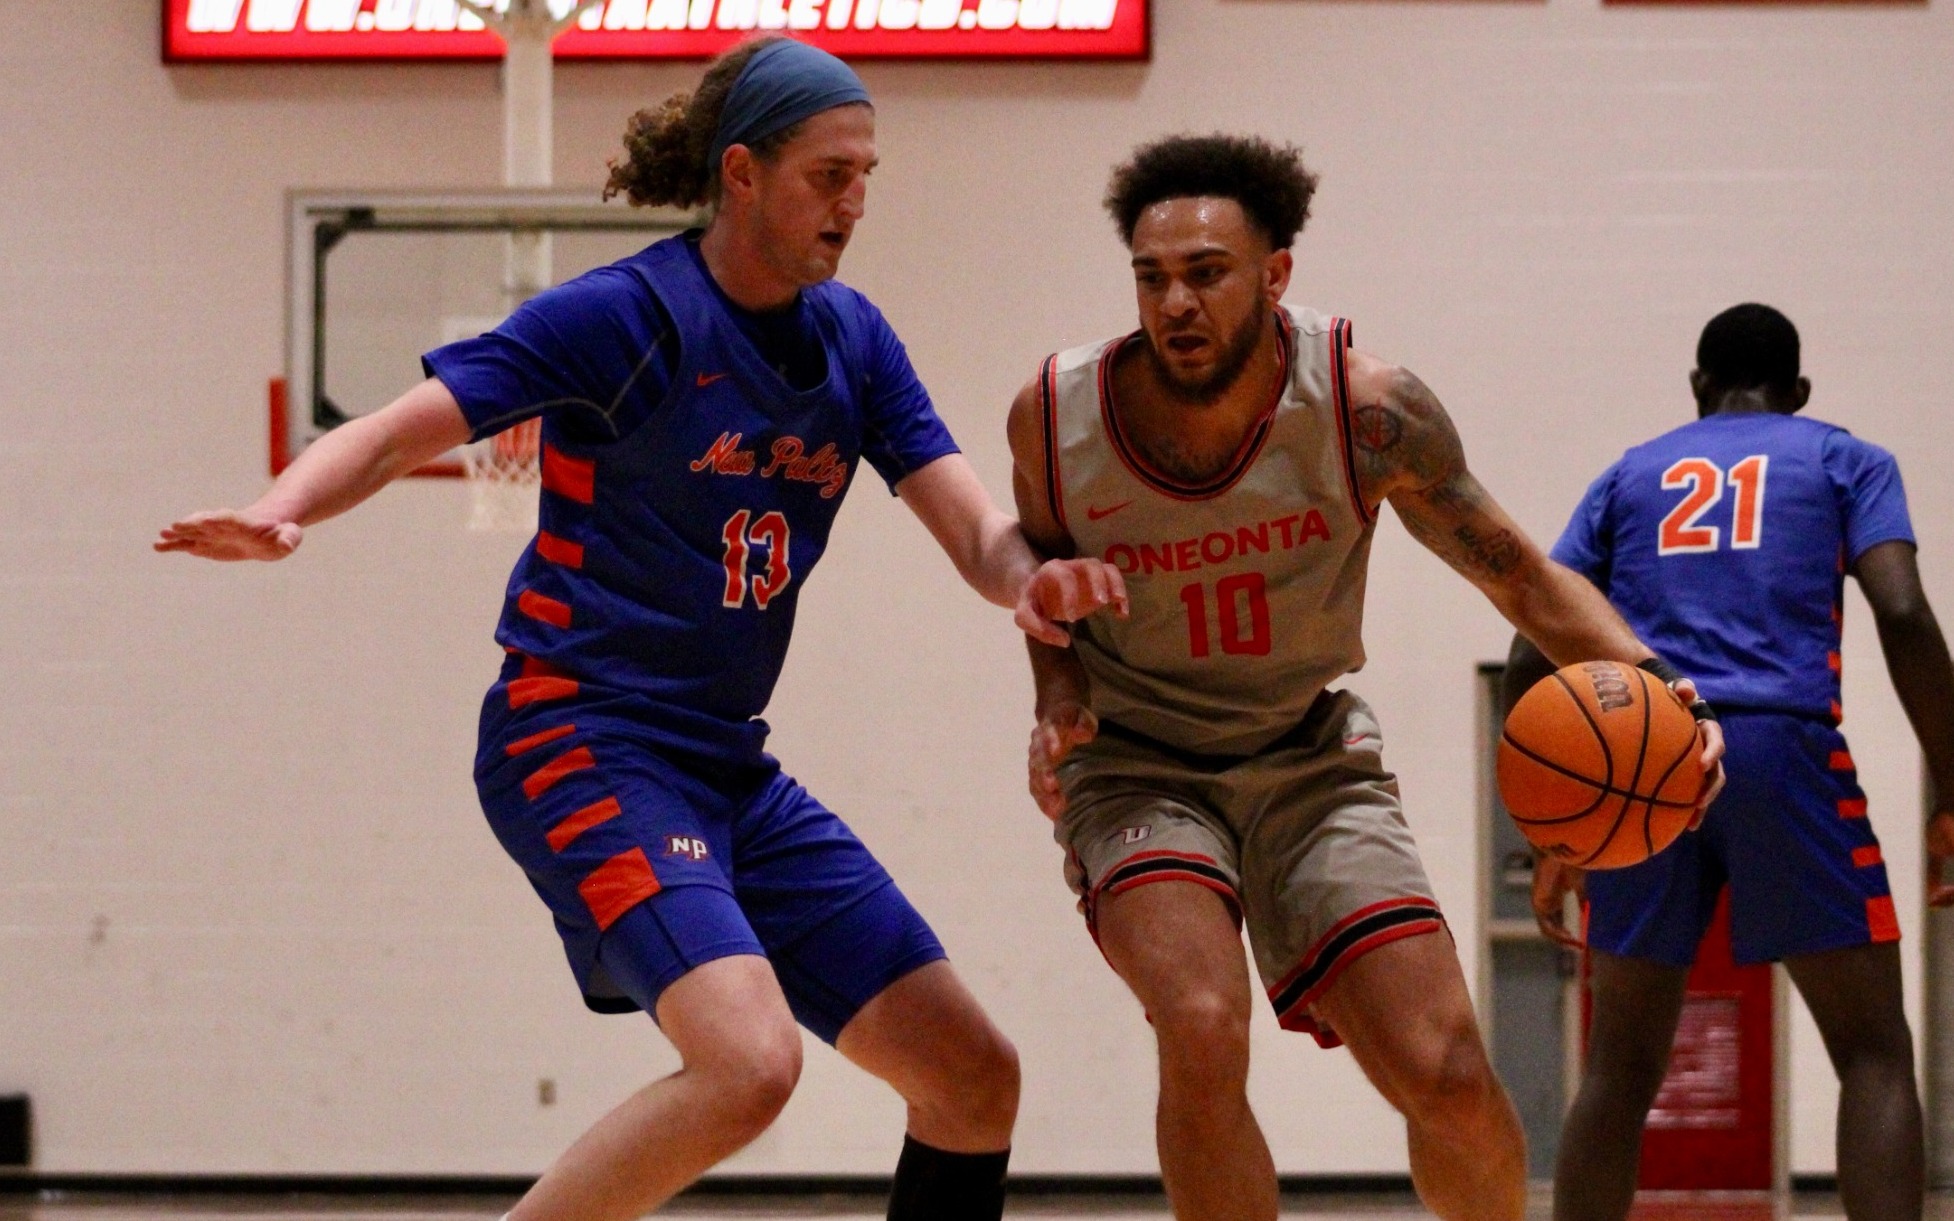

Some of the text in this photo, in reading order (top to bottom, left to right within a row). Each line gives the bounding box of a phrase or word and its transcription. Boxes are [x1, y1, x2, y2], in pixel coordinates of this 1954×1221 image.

[761, 436, 847, 498] Paltz
[1658, 454, 1769, 556] 21
[722, 509, 791, 610] 13
[1105, 509, 1331, 575] ONEONTA
[1180, 572, 1271, 658] 10
